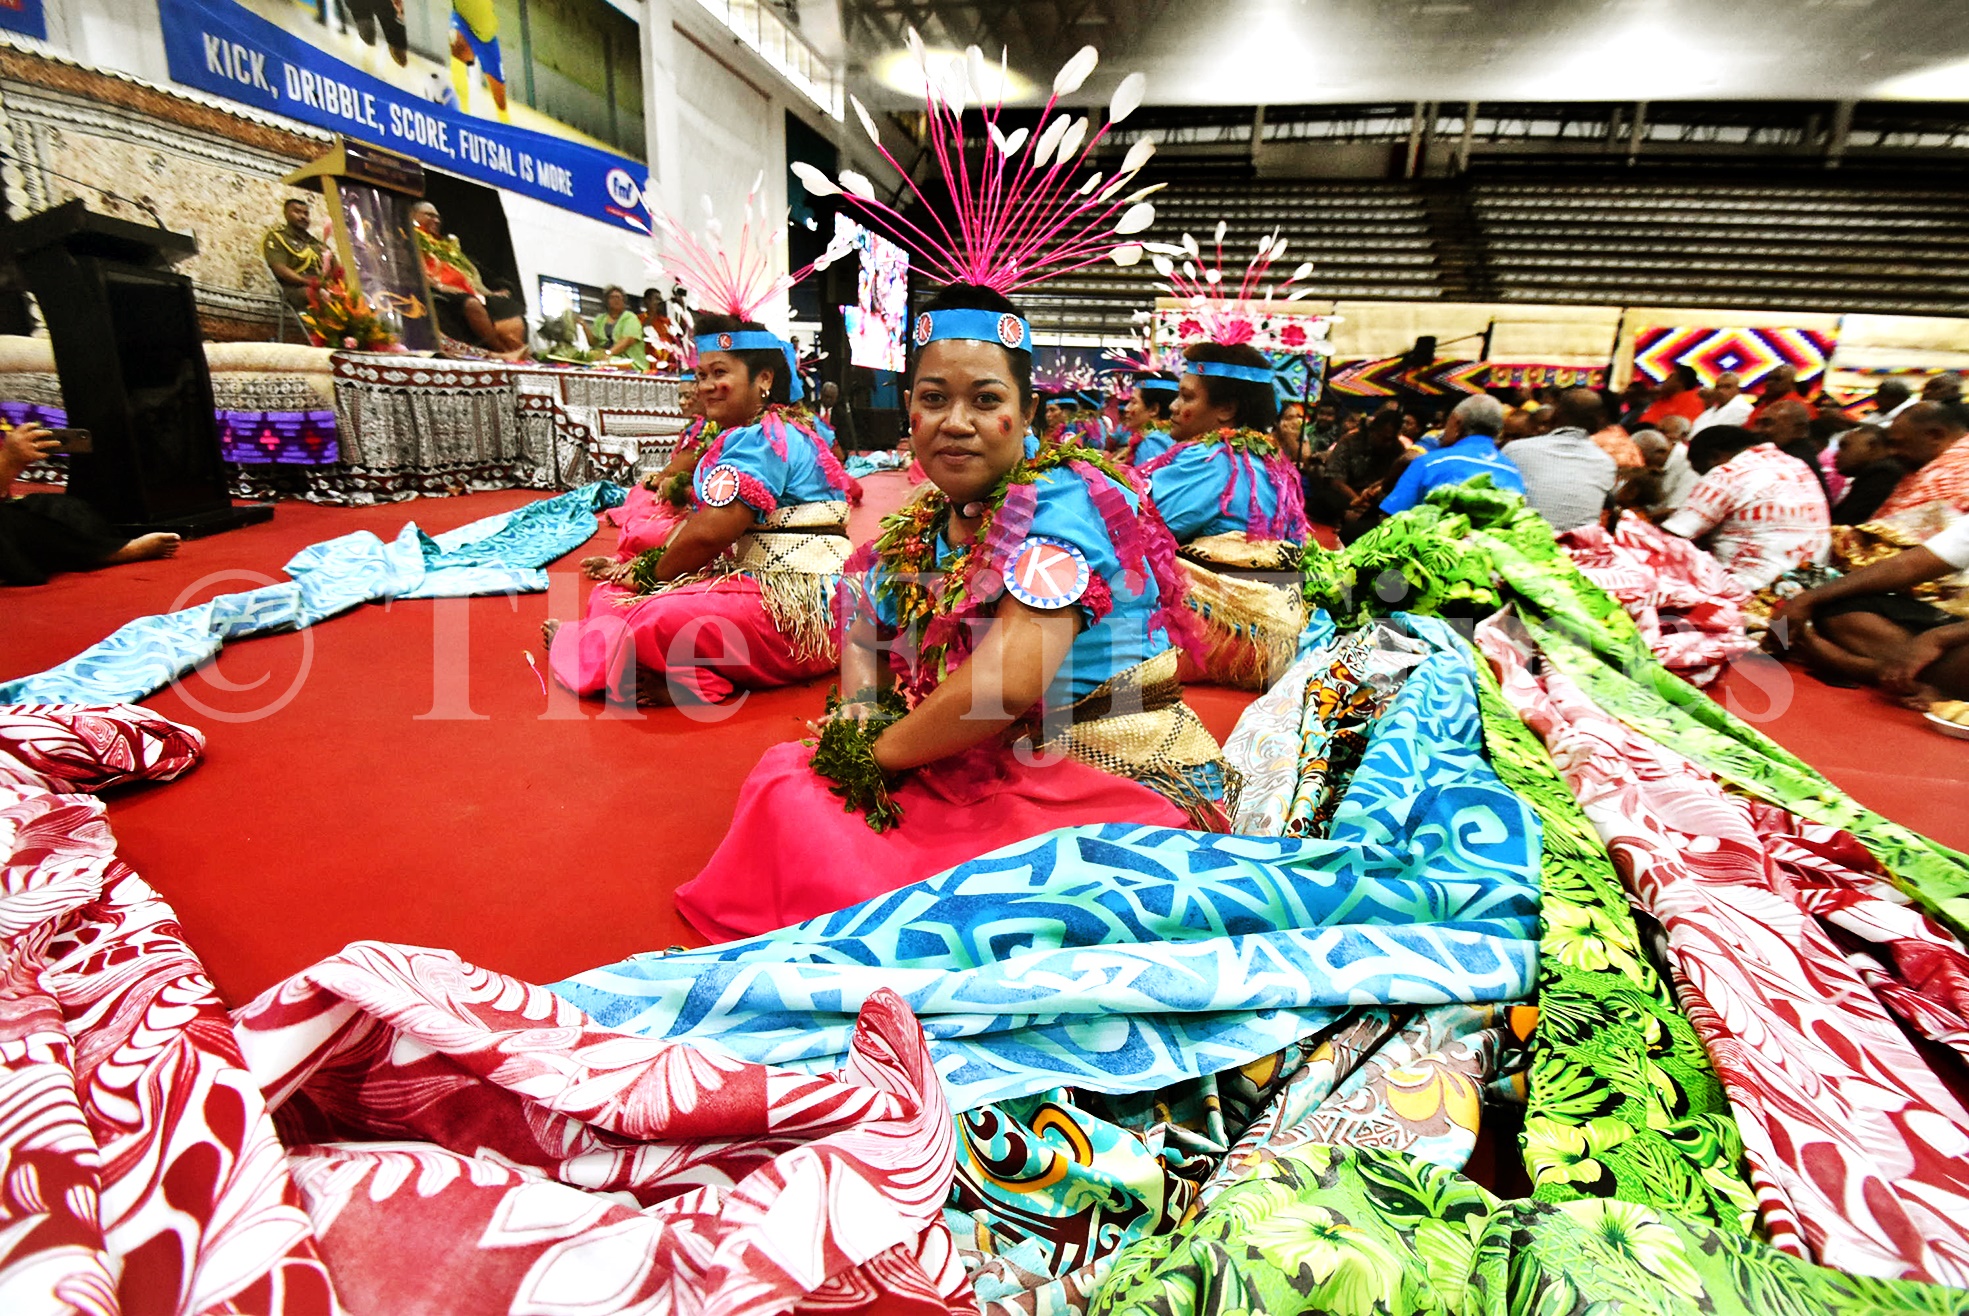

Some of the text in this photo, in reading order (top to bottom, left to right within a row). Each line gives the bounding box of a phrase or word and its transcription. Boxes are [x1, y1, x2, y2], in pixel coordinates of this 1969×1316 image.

[202, 31, 279, 100] KICK,
[283, 62, 386, 136] DRIBBLE,
[389, 102, 456, 160] SCORE,
[459, 129, 517, 178] FUTSAL
[518, 152, 535, 183] IS
[536, 158, 574, 198] MORE
[720, 335, 730, 347] K
[1003, 319, 1017, 342] K
[709, 470, 735, 501] K
[1021, 546, 1071, 597] K
